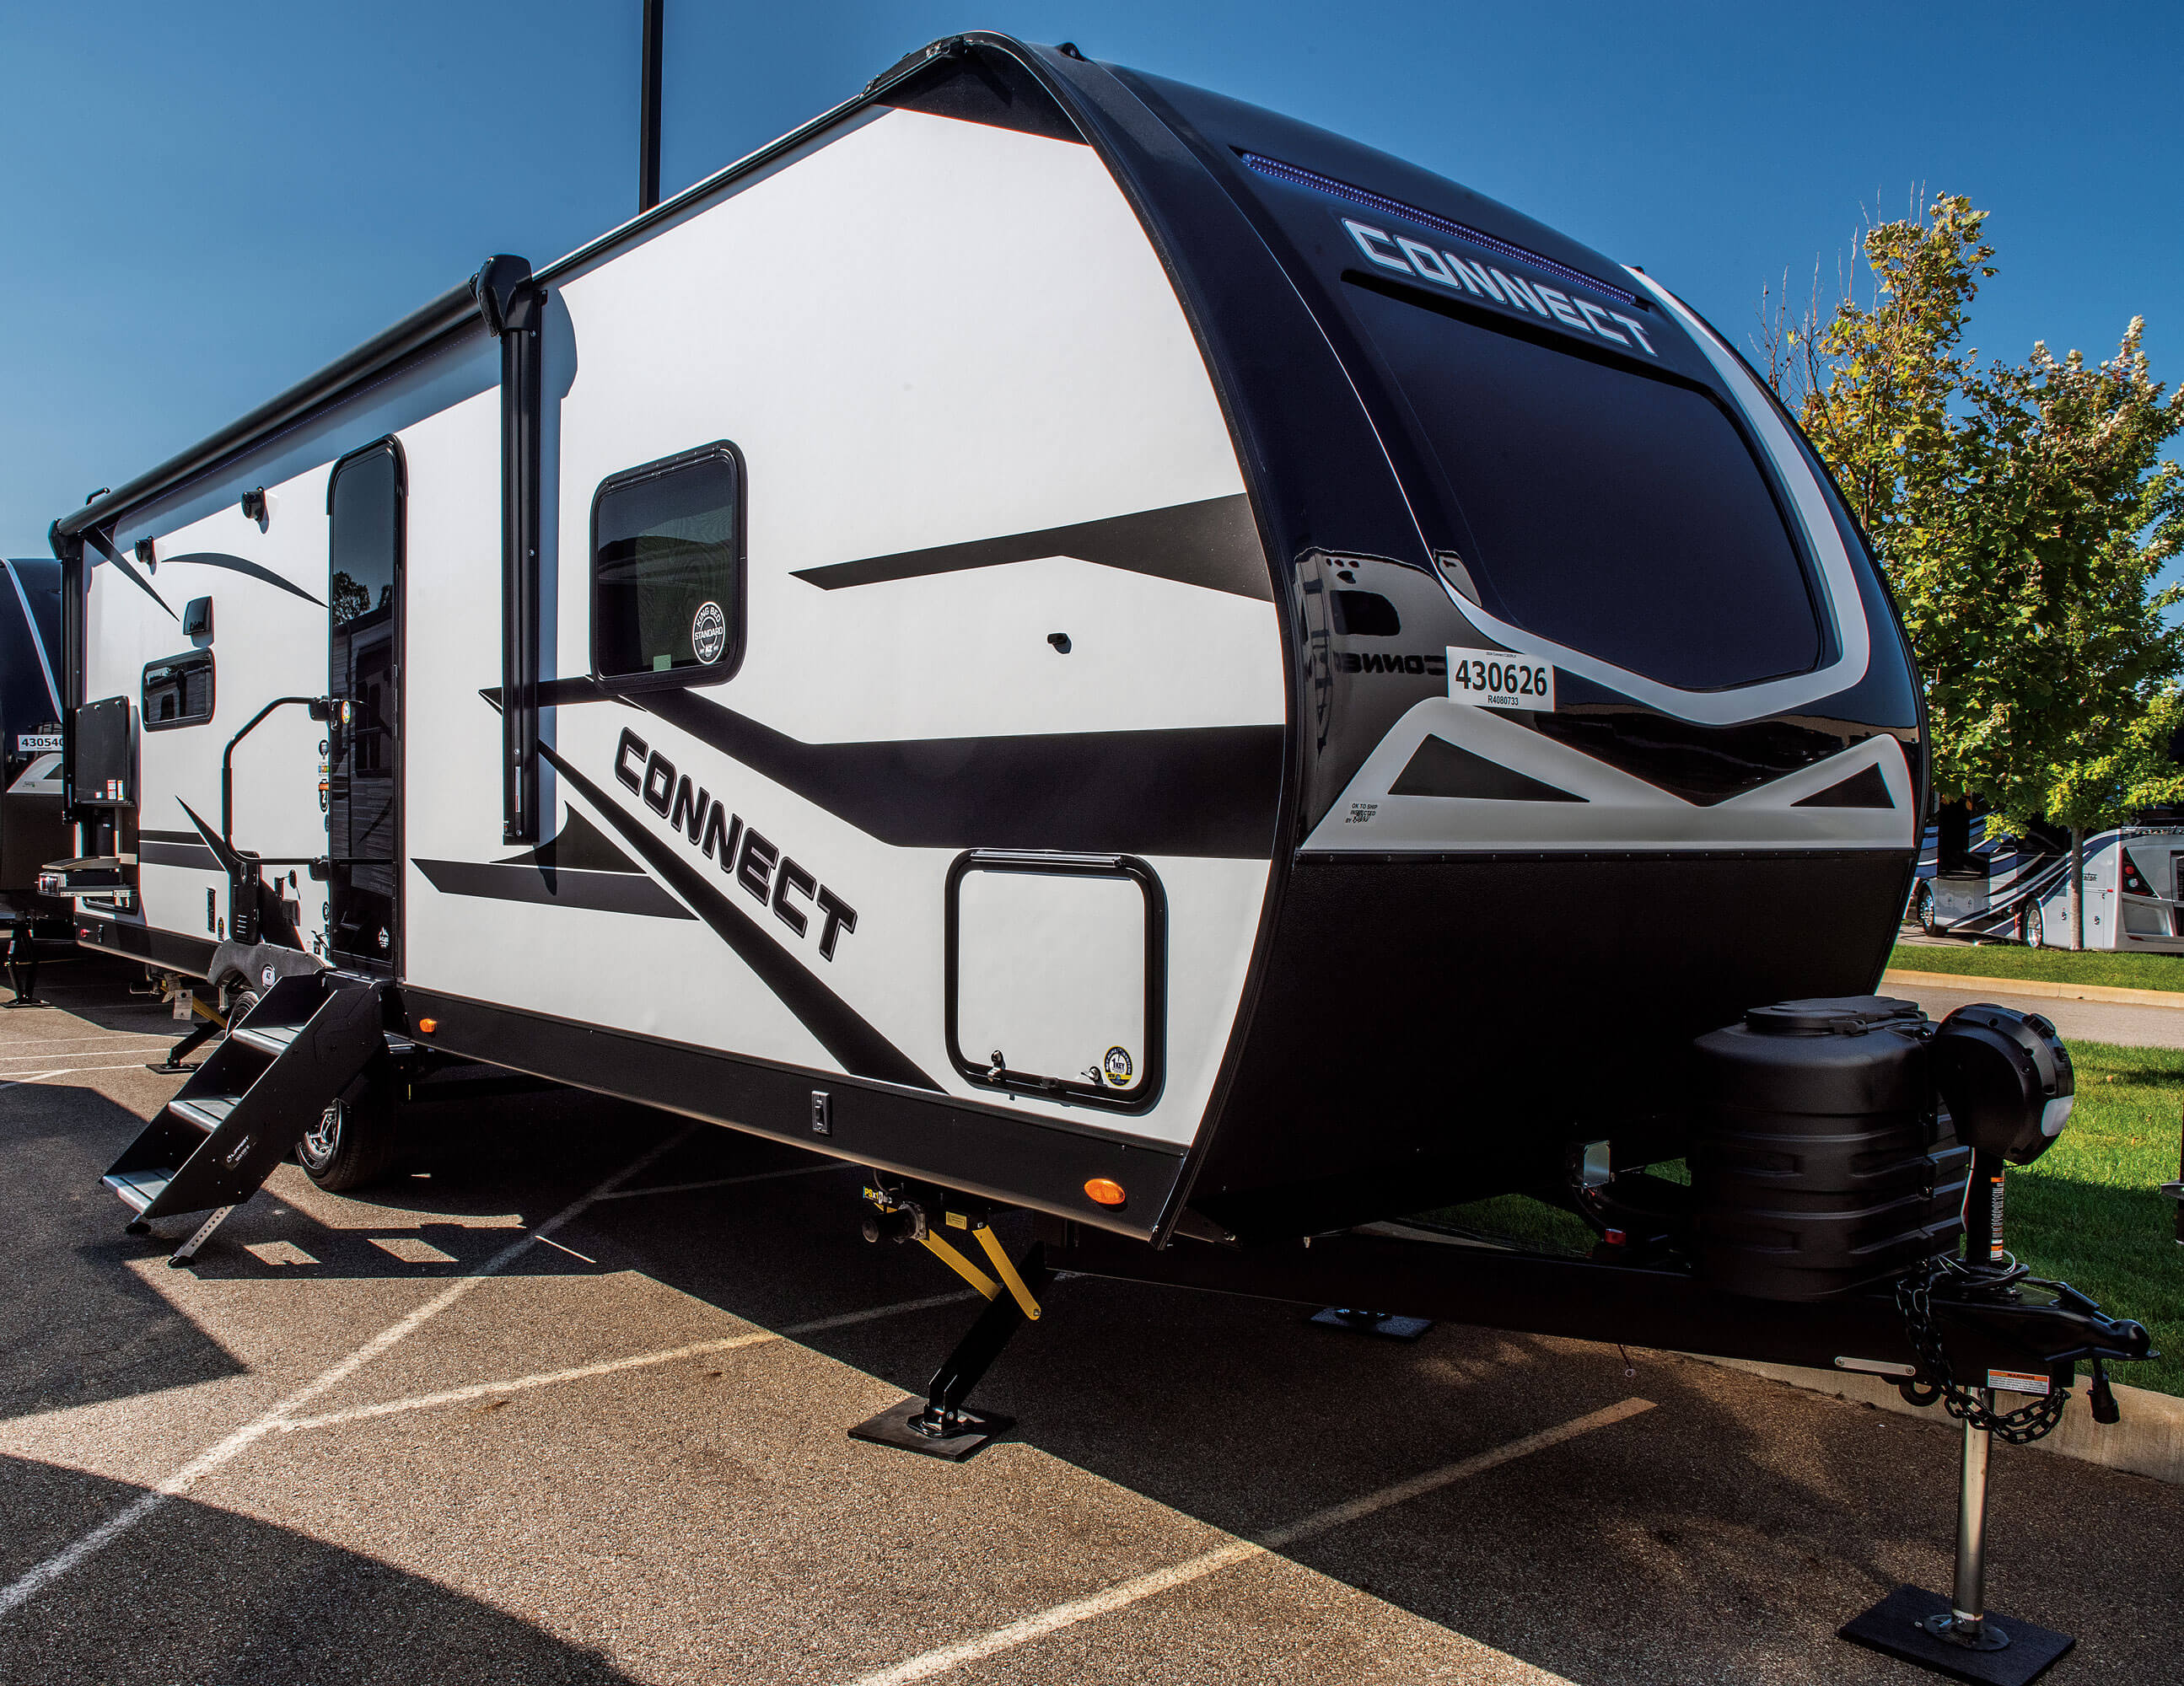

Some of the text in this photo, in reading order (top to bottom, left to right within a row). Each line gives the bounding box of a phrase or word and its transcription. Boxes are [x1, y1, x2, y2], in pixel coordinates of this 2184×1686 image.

[1342, 218, 1657, 357] CONNECT
[697, 607, 721, 627] KING BED
[695, 626, 723, 641] STANDARD
[1455, 660, 1547, 696] 430626
[1487, 695, 1519, 706] R4080733
[615, 727, 858, 963] CONNECT
